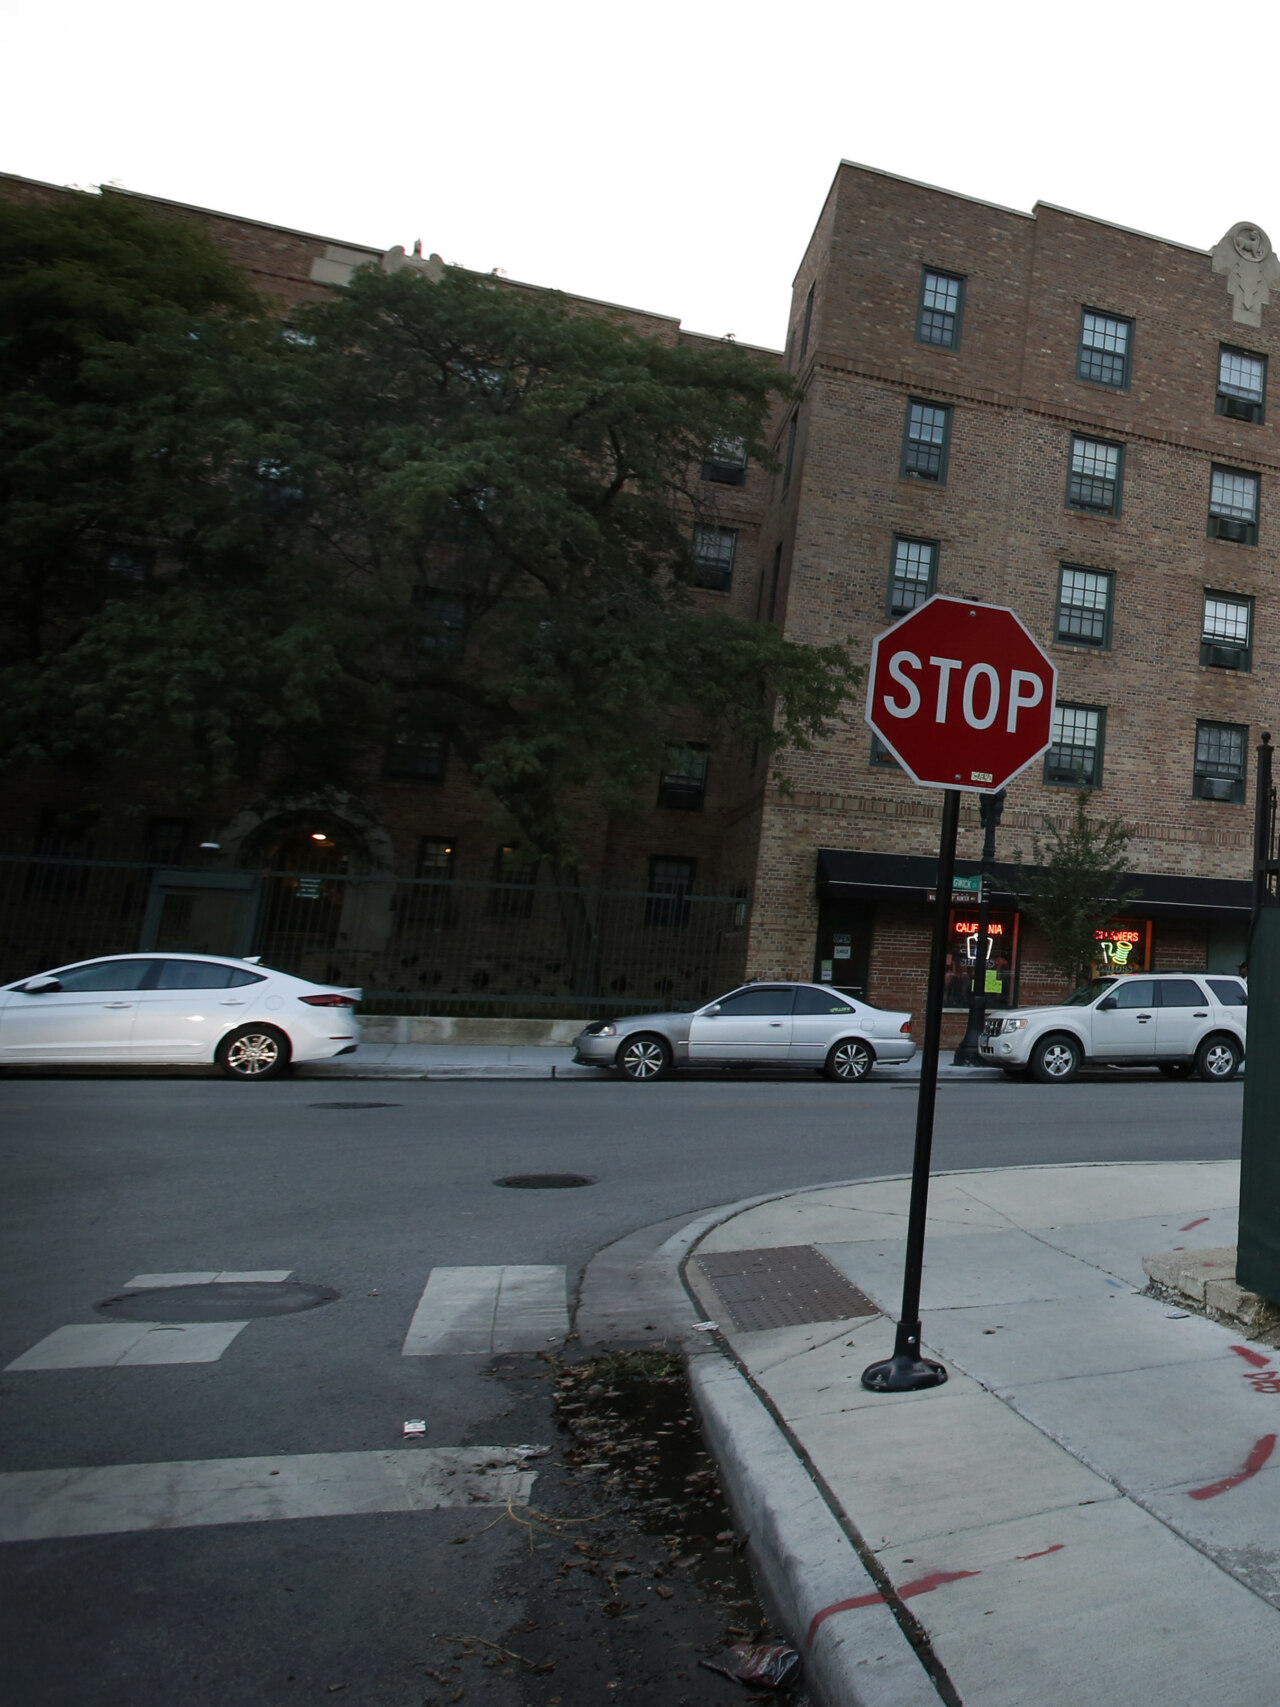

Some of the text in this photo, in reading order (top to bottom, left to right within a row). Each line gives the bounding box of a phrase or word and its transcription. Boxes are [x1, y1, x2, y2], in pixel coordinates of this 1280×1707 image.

[883, 650, 1044, 734] STOP
[955, 921, 1003, 935] CALIFNIA
[1095, 929, 1139, 942] ANERS
